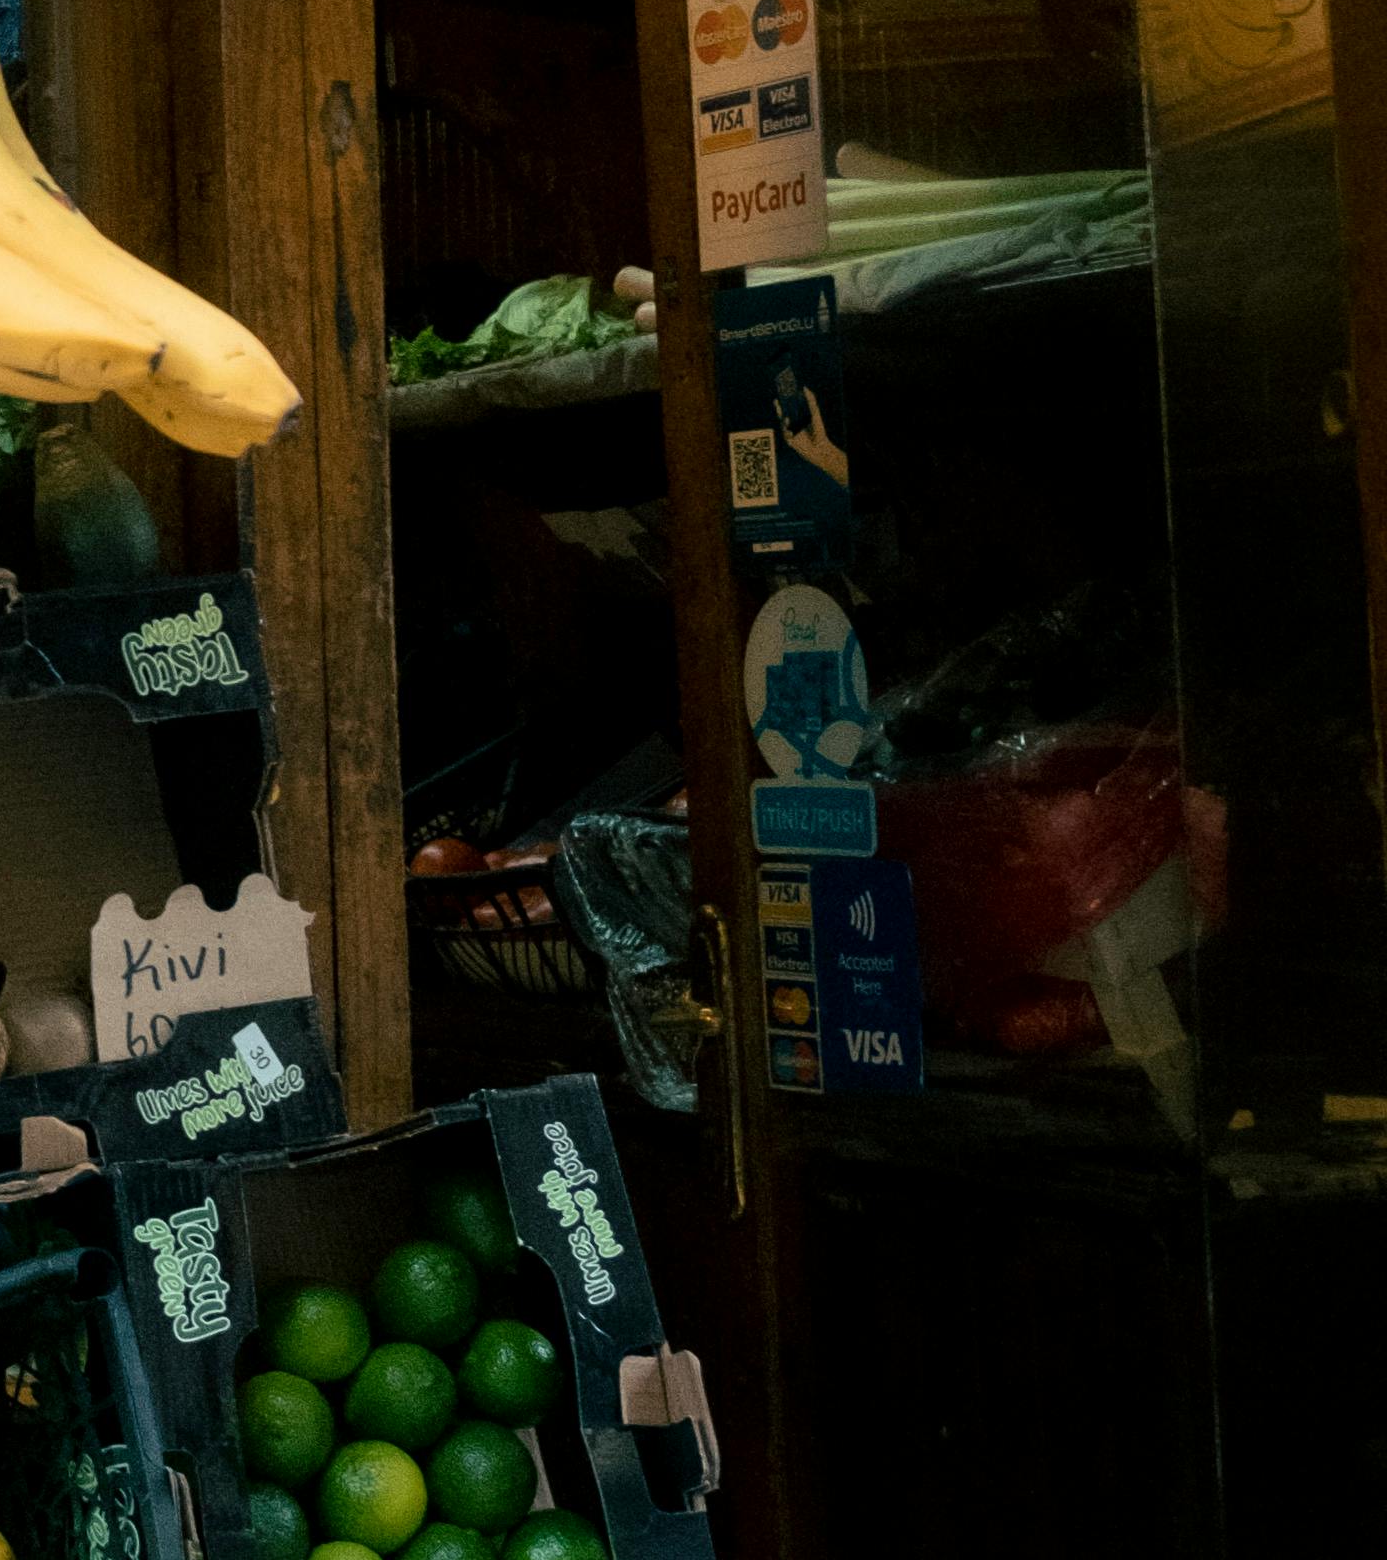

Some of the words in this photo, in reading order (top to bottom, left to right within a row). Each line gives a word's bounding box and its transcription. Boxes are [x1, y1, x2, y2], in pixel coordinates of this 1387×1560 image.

[770, 84, 797, 105] VISA
[711, 108, 744, 133] VISA
[762, 113, 808, 133] Electron
[711, 172, 806, 223] PayCard
[141, 592, 223, 647] green
[122, 632, 249, 696] Tasty
[768, 884, 800, 903] VISA
[122, 933, 226, 999] Kivi
[838, 953, 895, 974] Accepted
[852, 977, 884, 998] Here
[249, 1045, 271, 1070] 30
[842, 1028, 905, 1067] VISA
[181, 1090, 246, 1141] more
[573, 1187, 624, 1259] more
[134, 1217, 187, 1318] green
[169, 1196, 232, 1343] Tasty
